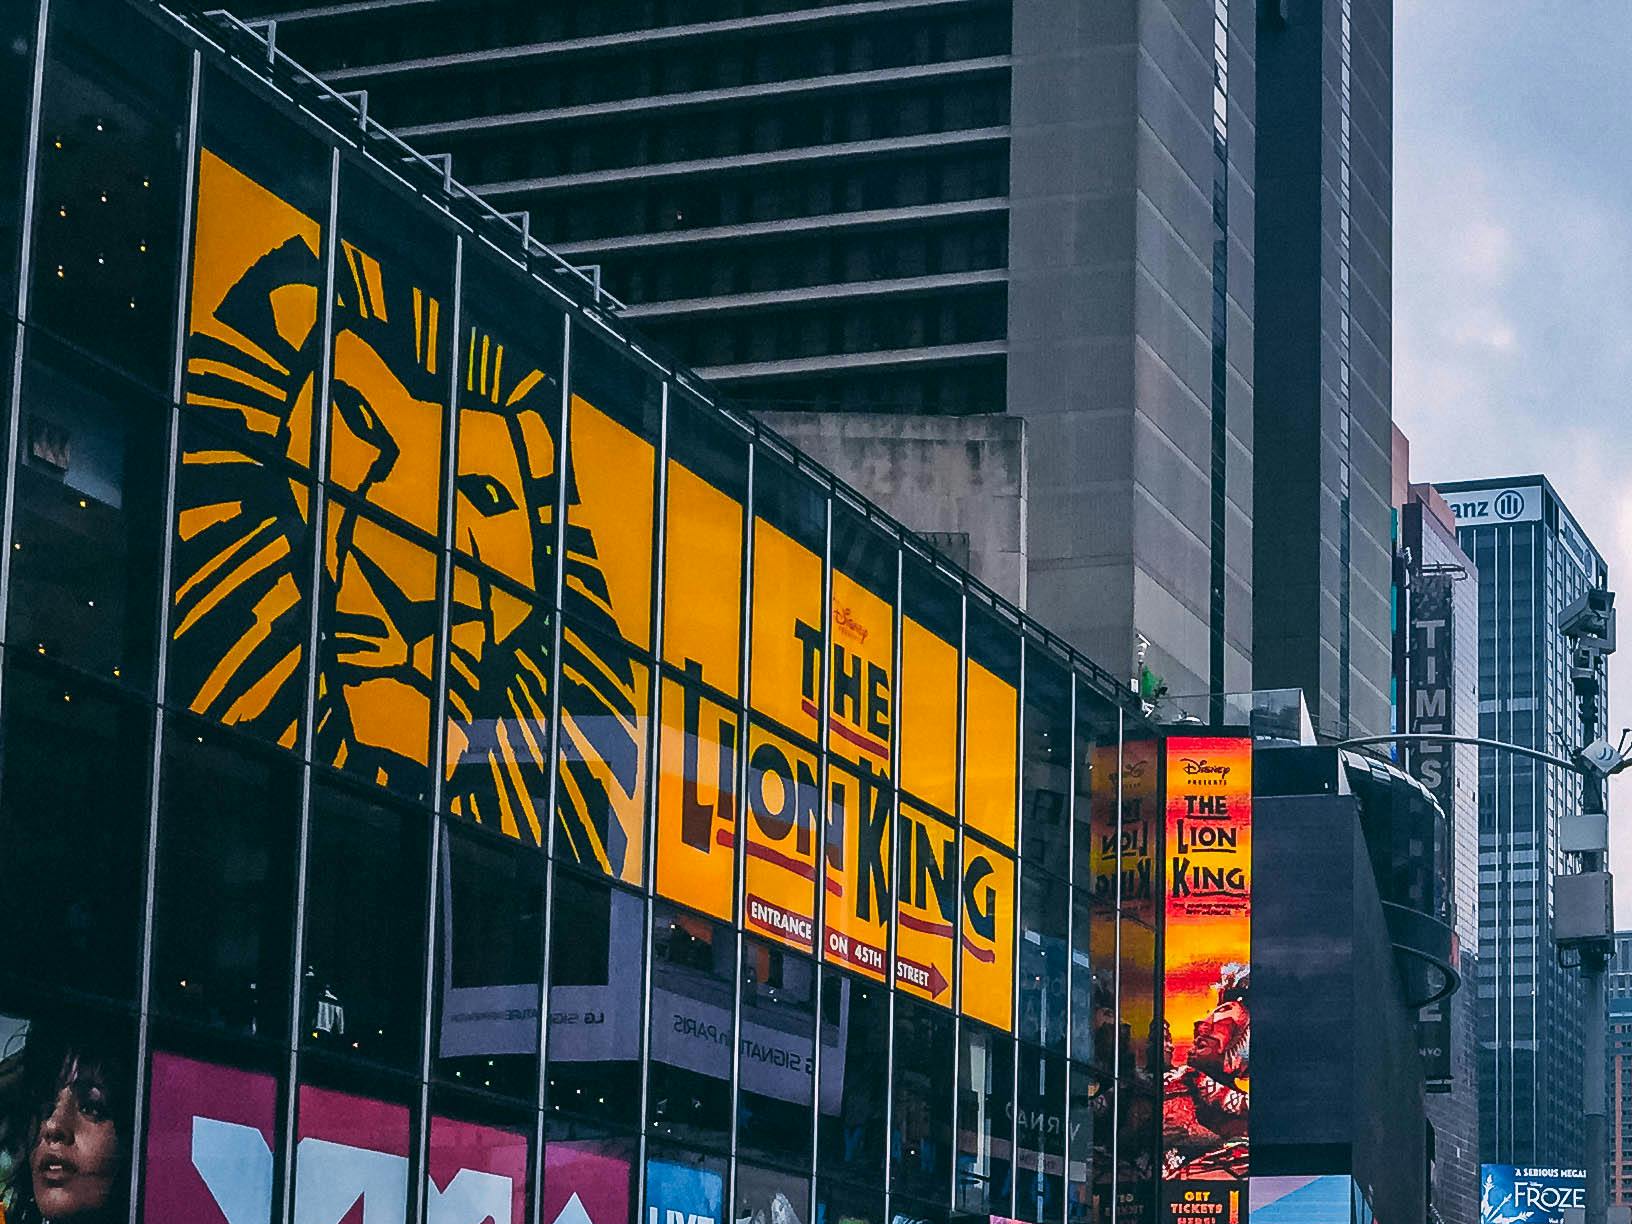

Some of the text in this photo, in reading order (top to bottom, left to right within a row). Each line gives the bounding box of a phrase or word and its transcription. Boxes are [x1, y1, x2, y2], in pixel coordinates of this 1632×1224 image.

[1450, 499, 1489, 519] anz
[794, 617, 890, 742] THE
[1415, 619, 1446, 792] TIMES
[682, 656, 845, 873] LION
[1179, 757, 1230, 779] Disney
[1184, 795, 1229, 817] THE
[856, 757, 996, 943] KING
[1176, 818, 1236, 854] LION
[1172, 857, 1245, 898] KING
[751, 901, 929, 988] ENTRANCE ON 45TH STREET
[1524, 1168, 1558, 1177] SERIOUS
[1171, 1203, 1223, 1214] TICKETS
[1184, 1191, 1210, 1202] GET
[1514, 1182, 1586, 1213] FROZE
